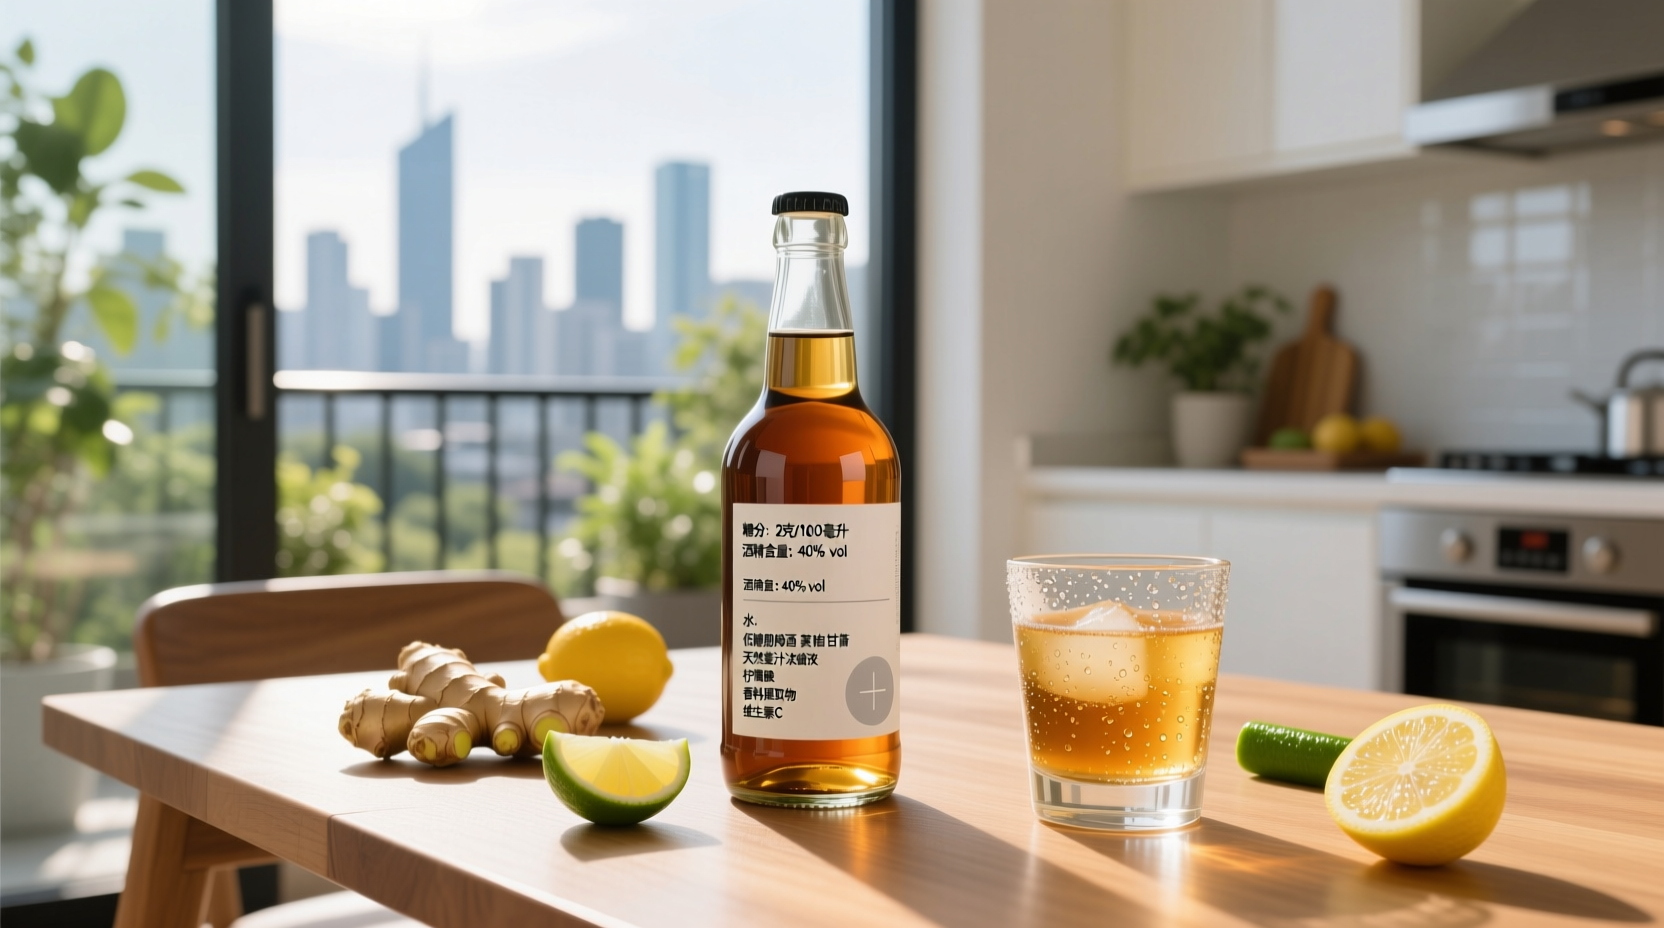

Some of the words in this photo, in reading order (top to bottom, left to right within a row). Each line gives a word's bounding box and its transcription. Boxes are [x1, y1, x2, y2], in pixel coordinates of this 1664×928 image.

[797, 544, 825, 557] 40%
[830, 545, 847, 557] vol
[782, 580, 806, 592] 40%
[808, 579, 825, 592] vol
